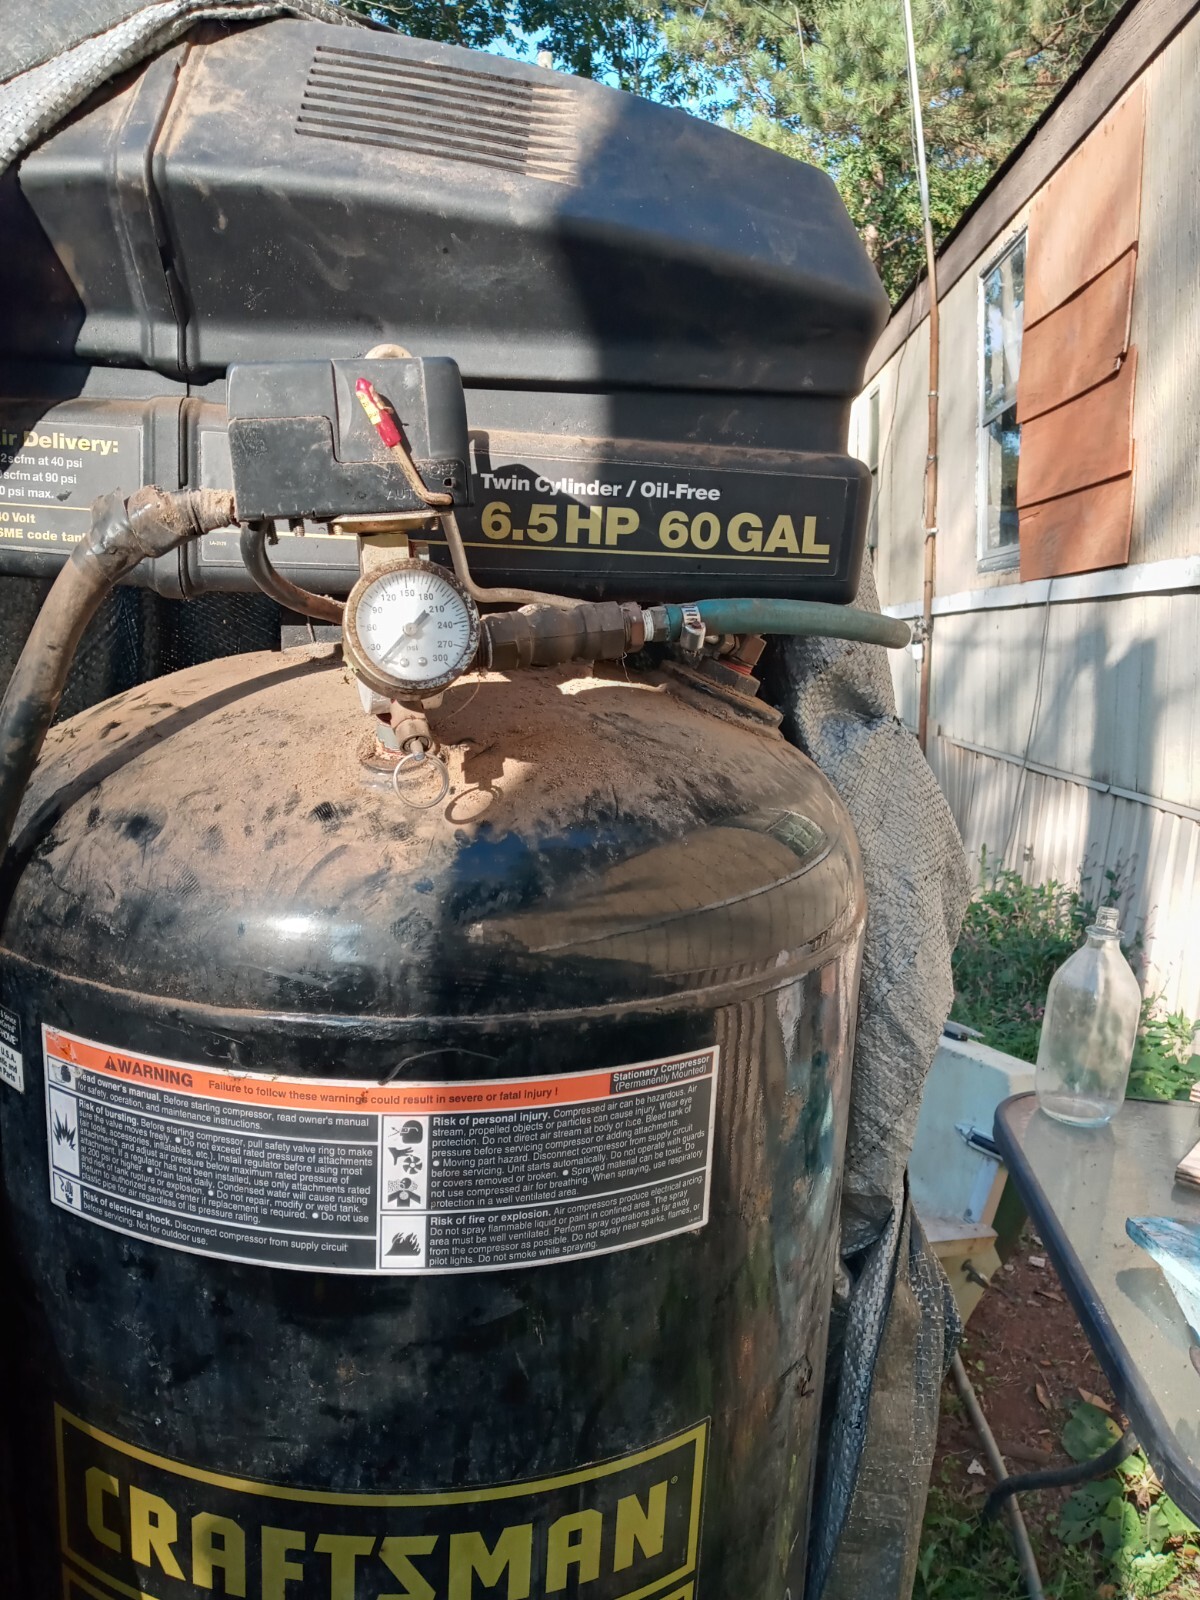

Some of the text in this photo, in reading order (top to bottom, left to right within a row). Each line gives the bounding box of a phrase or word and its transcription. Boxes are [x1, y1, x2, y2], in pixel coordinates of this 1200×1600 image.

[0, 429, 119, 455] ir Delivery:
[38, 456, 49, 466] at
[51, 456, 64, 467] 40
[66, 458, 83, 468] psi
[33, 472, 43, 482] at
[45, 472, 58, 483] 90
[61, 474, 77, 485] psi
[480, 473, 721, 501] Twin Cylinder / Oil-Free
[8, 487, 24, 498] psi
[28, 489, 54, 499] max.
[12, 512, 36, 524] Volt
[27, 530, 57, 541] code
[437, 621, 453, 629] 240
[433, 654, 448, 662] 300
[117, 1058, 193, 1087] WARNING
[208, 1080, 241, 1094] Failure
[244, 1086, 254, 1094] to
[256, 1088, 286, 1098] follow
[289, 1091, 317, 1101] these
[320, 1093, 368, 1105] warnings
[370, 1096, 400, 1104] could
[403, 1095, 433, 1104] result
[436, 1095, 446, 1103] in
[449, 1094, 483, 1103] severe
[486, 1093, 496, 1101] or
[500, 1091, 521, 1100] fatal
[524, 1089, 552, 1099] injury
[613, 1056, 710, 1082] Stationary Compressor
[615, 1064, 706, 1092] (Permanently Mounted)
[78, 1074, 369, 1126] ead owner's manual. Before starting compressor, read owner's manual
[78, 1081, 263, 1130] for safety, operation, and maintenance instructions.
[433, 1117, 456, 1126] Risk
[459, 1116, 470, 1125] of
[472, 1113, 517, 1127] personal
[520, 1111, 551, 1123] injury.
[553, 1103, 605, 1118] Compressed
[608, 1101, 617, 1110] air
[620, 1100, 633, 1108] can
[647, 1091, 686, 1103] hazardous.
[688, 1085, 698, 1094] Air
[78, 1099, 373, 1157] Risk of bursting. Before starting compressor, pull safety valve ring to make
[432, 1097, 692, 1136] stream, propelled objects or particles can cause injury. Wear eye
[432, 1119, 679, 1159] pressure before servicing compressor or adding attachments.
[430, 1175, 703, 1226] Risk of fire or explosion. Air compressors produce electrical arcing.
[431, 1199, 474, 1209] protection
[496, 1195, 513, 1204] well
[515, 1191, 556, 1202] ventilated
[558, 1188, 579, 1198] area.
[83, 1190, 348, 1252] Risk of electrical shock. Disconnect compressor from supply circuit
[83, 1201, 208, 1245] before servicing. Not for outdoor use.
[429, 1241, 598, 1267] pilot lights. Do not smoke while spraying.
[85, 1466, 668, 1600] CRAFTSMAN
